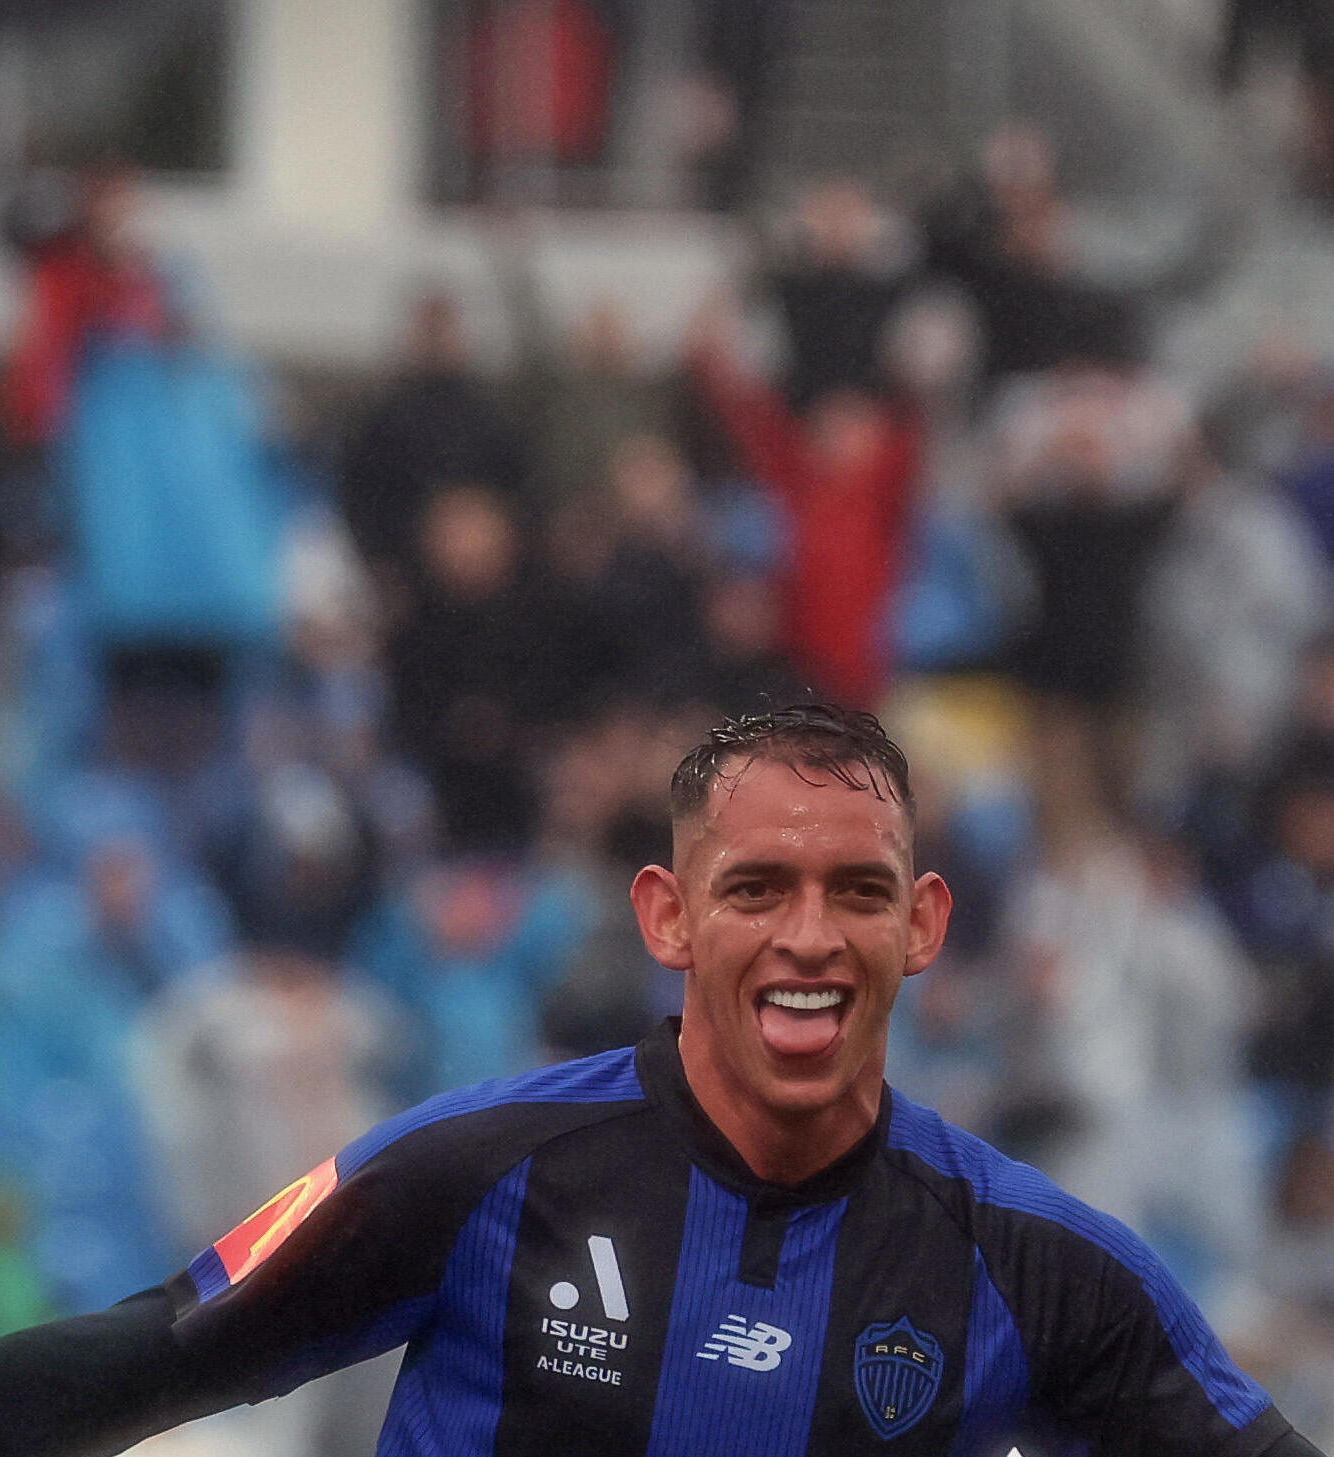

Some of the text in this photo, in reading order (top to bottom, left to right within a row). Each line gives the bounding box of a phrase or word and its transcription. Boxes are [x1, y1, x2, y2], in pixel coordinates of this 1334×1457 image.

[541, 1317, 628, 1350] ISUZU
[556, 1340, 607, 1360] UTE
[536, 1355, 622, 1386] A-LEAGUE
